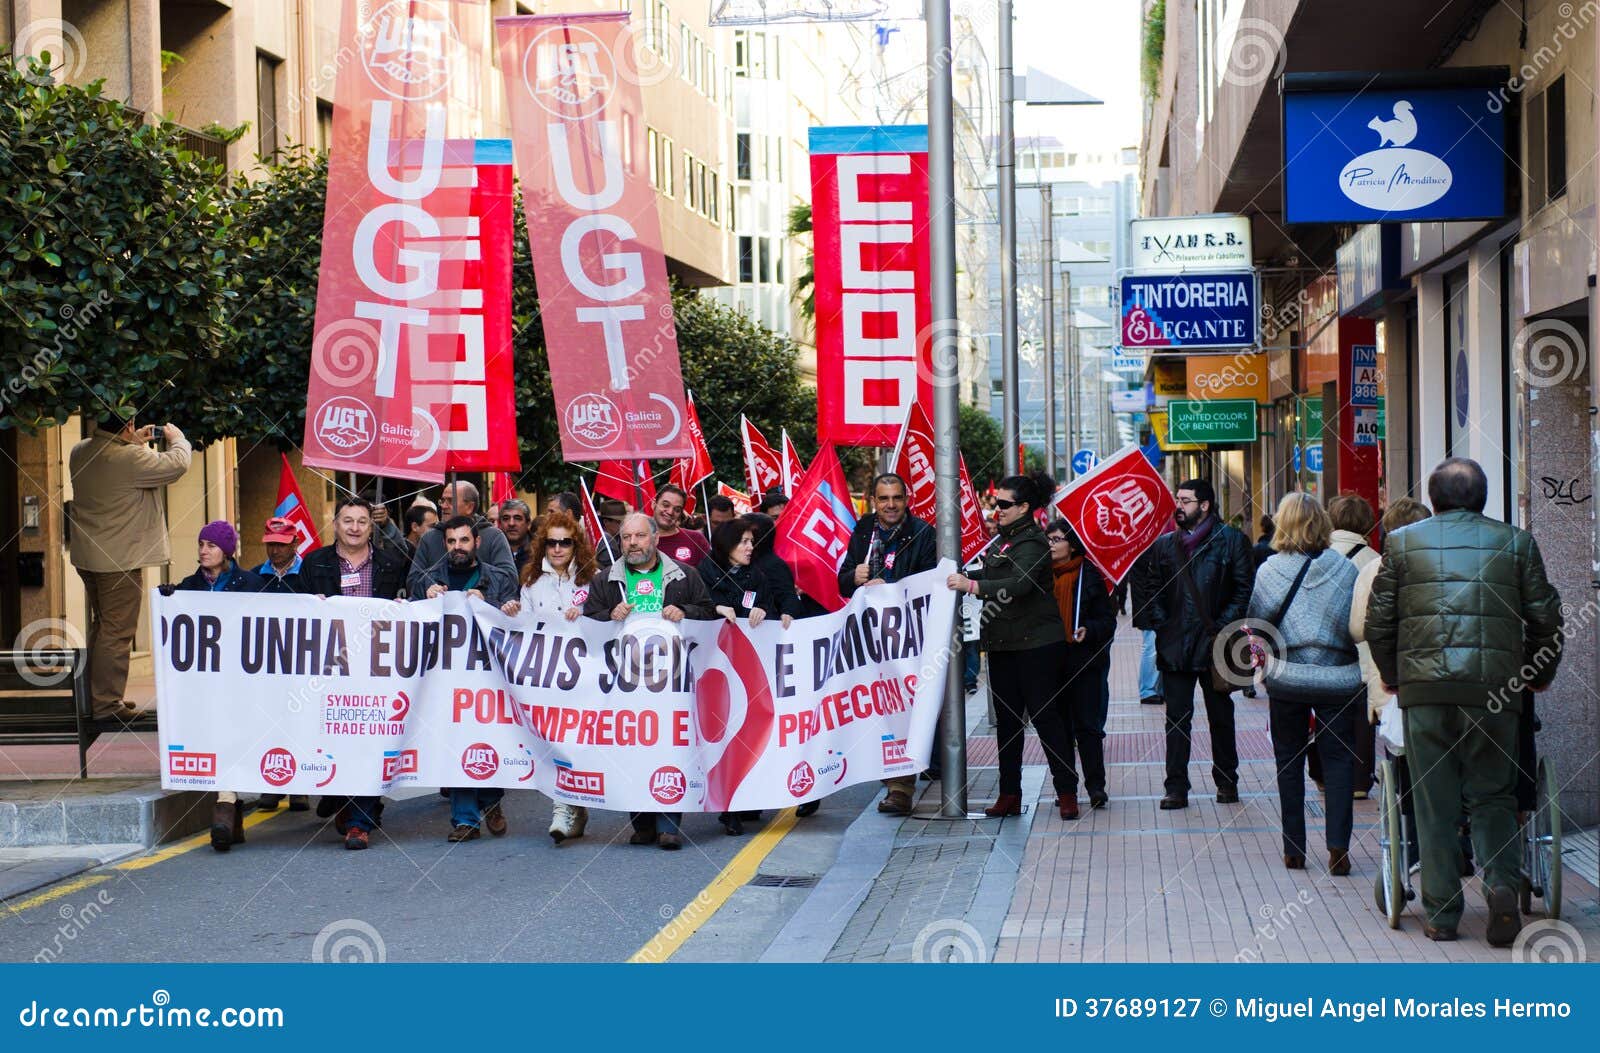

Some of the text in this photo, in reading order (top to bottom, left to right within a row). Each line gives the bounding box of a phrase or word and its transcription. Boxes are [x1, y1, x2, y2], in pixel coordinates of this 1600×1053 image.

[1344, 163, 1447, 193] Patricia Mendiluce
[353, 101, 446, 398] UGT
[547, 121, 646, 390] UGT
[836, 155, 917, 424] CCOO
[1131, 282, 1248, 309] TINTORERIA
[1127, 310, 1246, 343] ELEGANTE
[1195, 373, 1258, 388] GOCCO
[322, 406, 368, 433] UGT
[573, 403, 613, 425] UGT
[625, 411, 662, 422] Galicia
[1178, 412, 1248, 421] UNITED COLORS
[381, 422, 420, 437] Galicia
[1179, 423, 1190, 431] OF
[1108, 479, 1155, 527] UGT
[240, 616, 350, 676] UNHA
[488, 621, 587, 691] MÁIS
[775, 643, 796, 698] E
[327, 694, 388, 707] SYNDICAT
[325, 722, 405, 735] TRADE UNION
[672, 710, 689, 747] E
[265, 753, 292, 769] UGT
[466, 749, 495, 764] UGT
[503, 758, 529, 767] Galicia
[300, 763, 328, 772] Galicia
[817, 761, 841, 776] Galicia
[558, 768, 601, 792] CCOO
[653, 771, 683, 788] UGT
